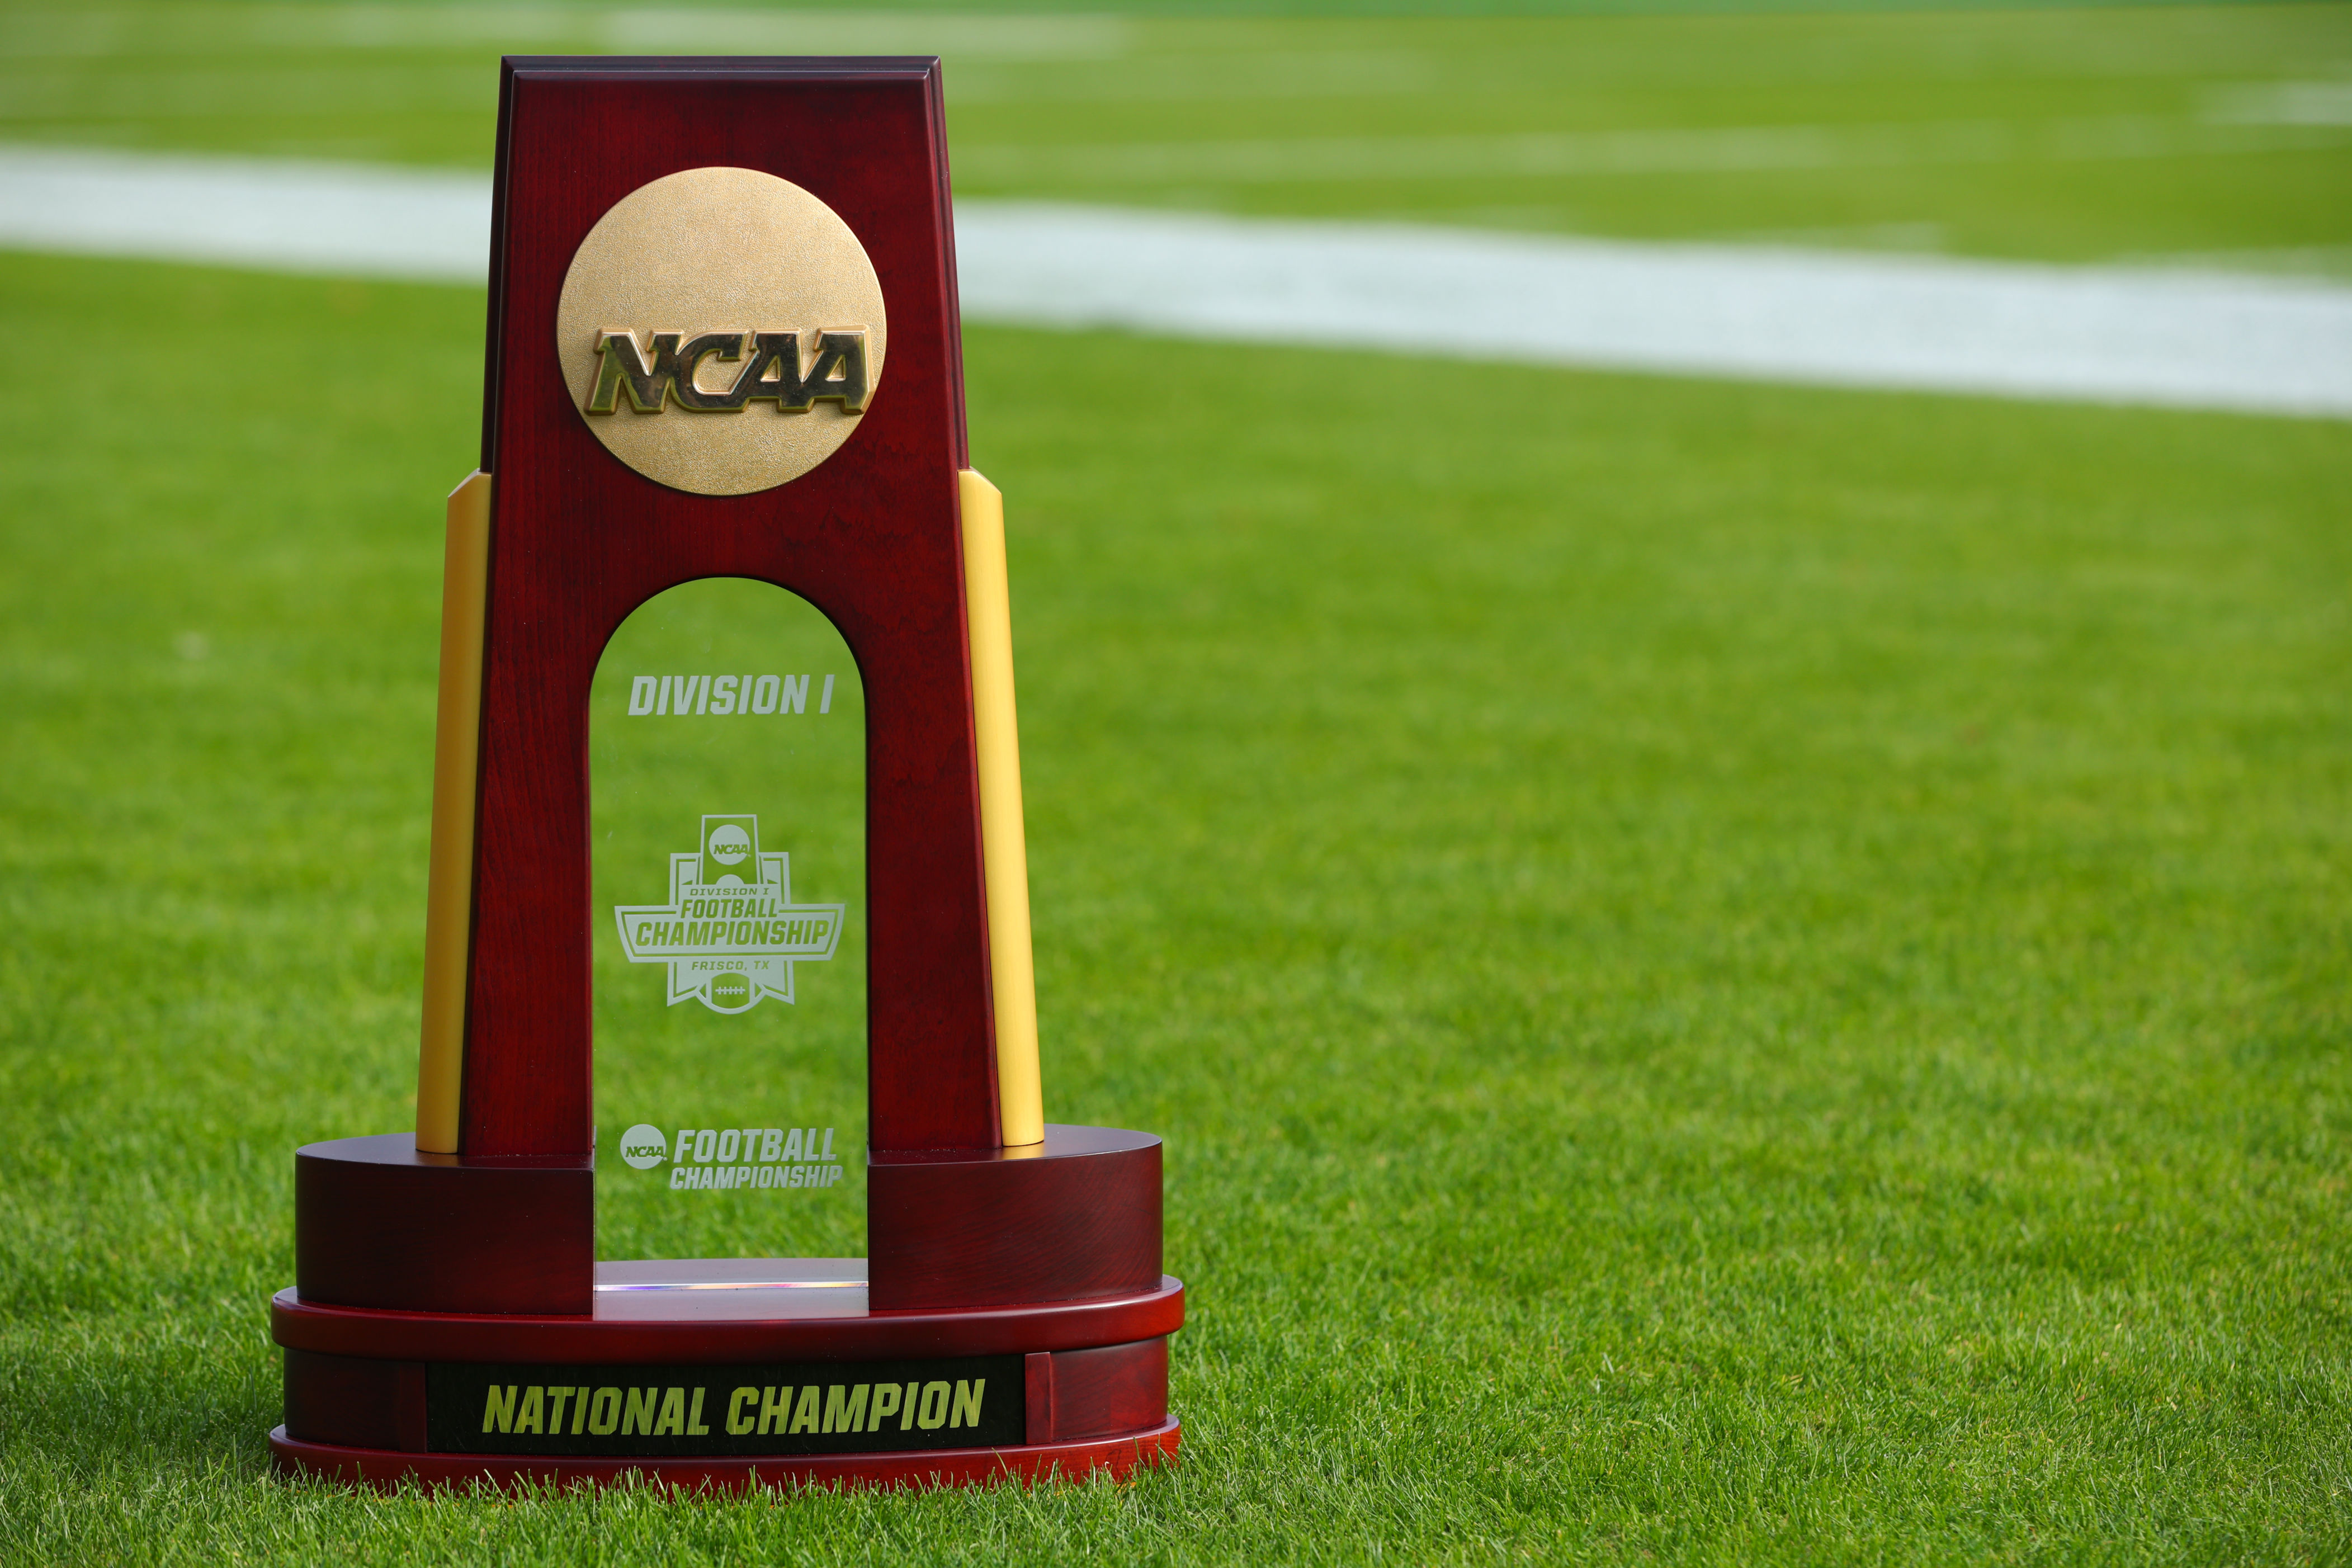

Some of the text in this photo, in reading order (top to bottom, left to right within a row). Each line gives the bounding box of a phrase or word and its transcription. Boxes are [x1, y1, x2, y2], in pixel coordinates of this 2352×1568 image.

[583, 324, 873, 414] NCAA
[628, 674, 835, 715] DIVISION I
[714, 844, 749, 855] NCAA
[689, 887, 769, 896] DIVISION I
[680, 898, 778, 919] FOOTBALL
[635, 919, 829, 946] CHAMPIONSHIP
[691, 960, 769, 971] FRISCO, TX
[625, 1146, 665, 1158] NCAA
[673, 1128, 837, 1164] FOOTBALL
[670, 1165, 843, 1189] CHAMPIONSHIP
[482, 1378, 986, 1435] NATIONAL CHAMPION
